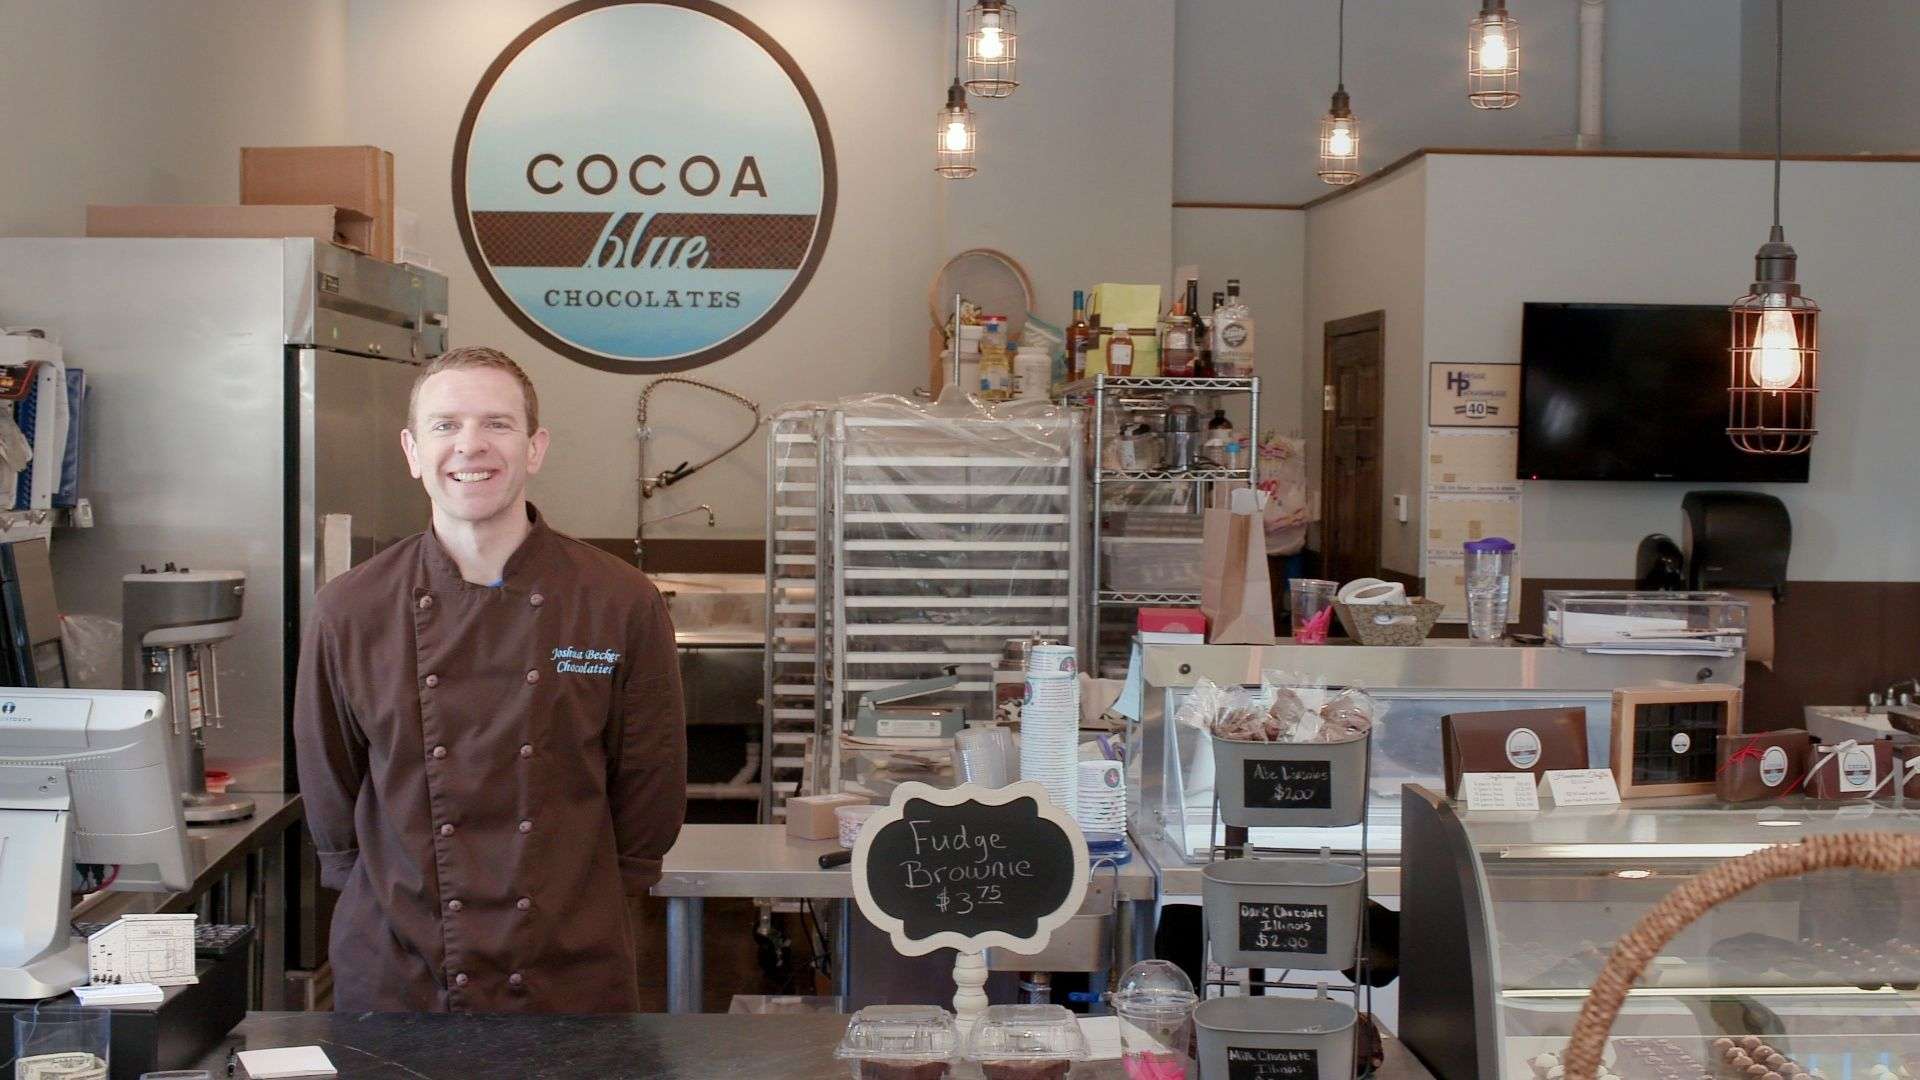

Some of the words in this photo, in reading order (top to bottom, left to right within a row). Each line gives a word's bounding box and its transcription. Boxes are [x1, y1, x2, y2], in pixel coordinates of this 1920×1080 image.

[526, 153, 768, 198] COCOA
[582, 209, 710, 271] blue
[544, 289, 741, 309] CHOCOLATES
[1468, 403, 1484, 414] 40
[551, 646, 583, 660] Joshua
[585, 648, 621, 662] Becker
[557, 660, 615, 674] Chocolatier
[909, 820, 1008, 863] Fudge
[900, 859, 1034, 888] Brownie
[1241, 905, 1270, 918] Dark
[1260, 920, 1312, 932] Illinois
[1256, 932, 1308, 948] $2.00
